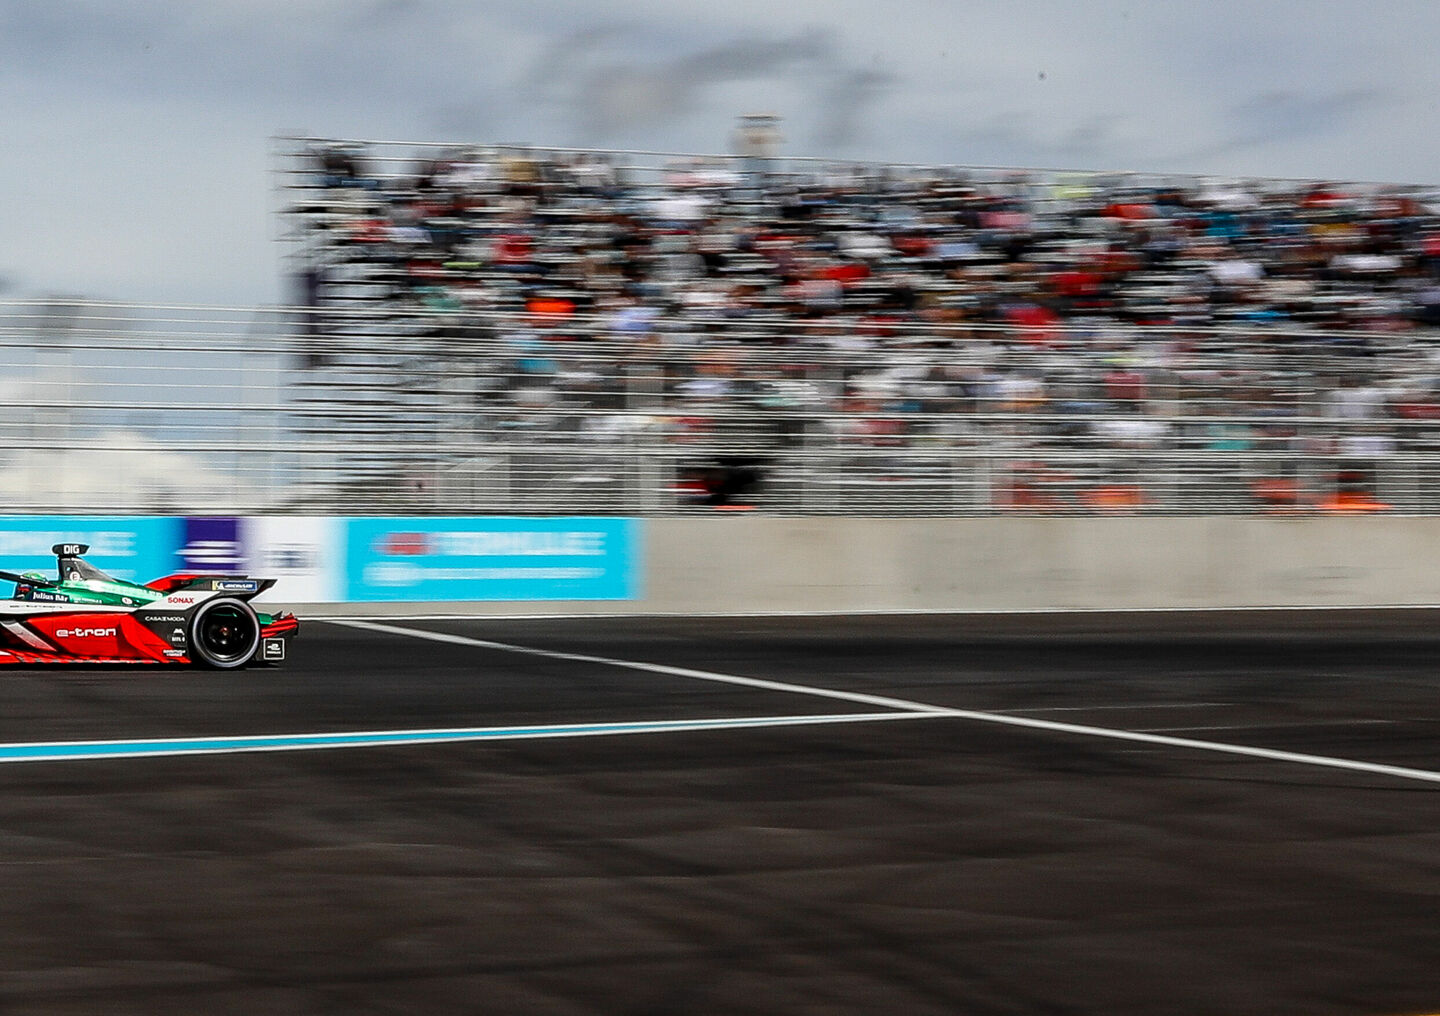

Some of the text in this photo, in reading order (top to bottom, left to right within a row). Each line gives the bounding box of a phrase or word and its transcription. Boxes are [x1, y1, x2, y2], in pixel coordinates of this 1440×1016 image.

[63, 544, 80, 554] DIG
[32, 591, 54, 600] Julius
[56, 628, 117, 637] e-tron
